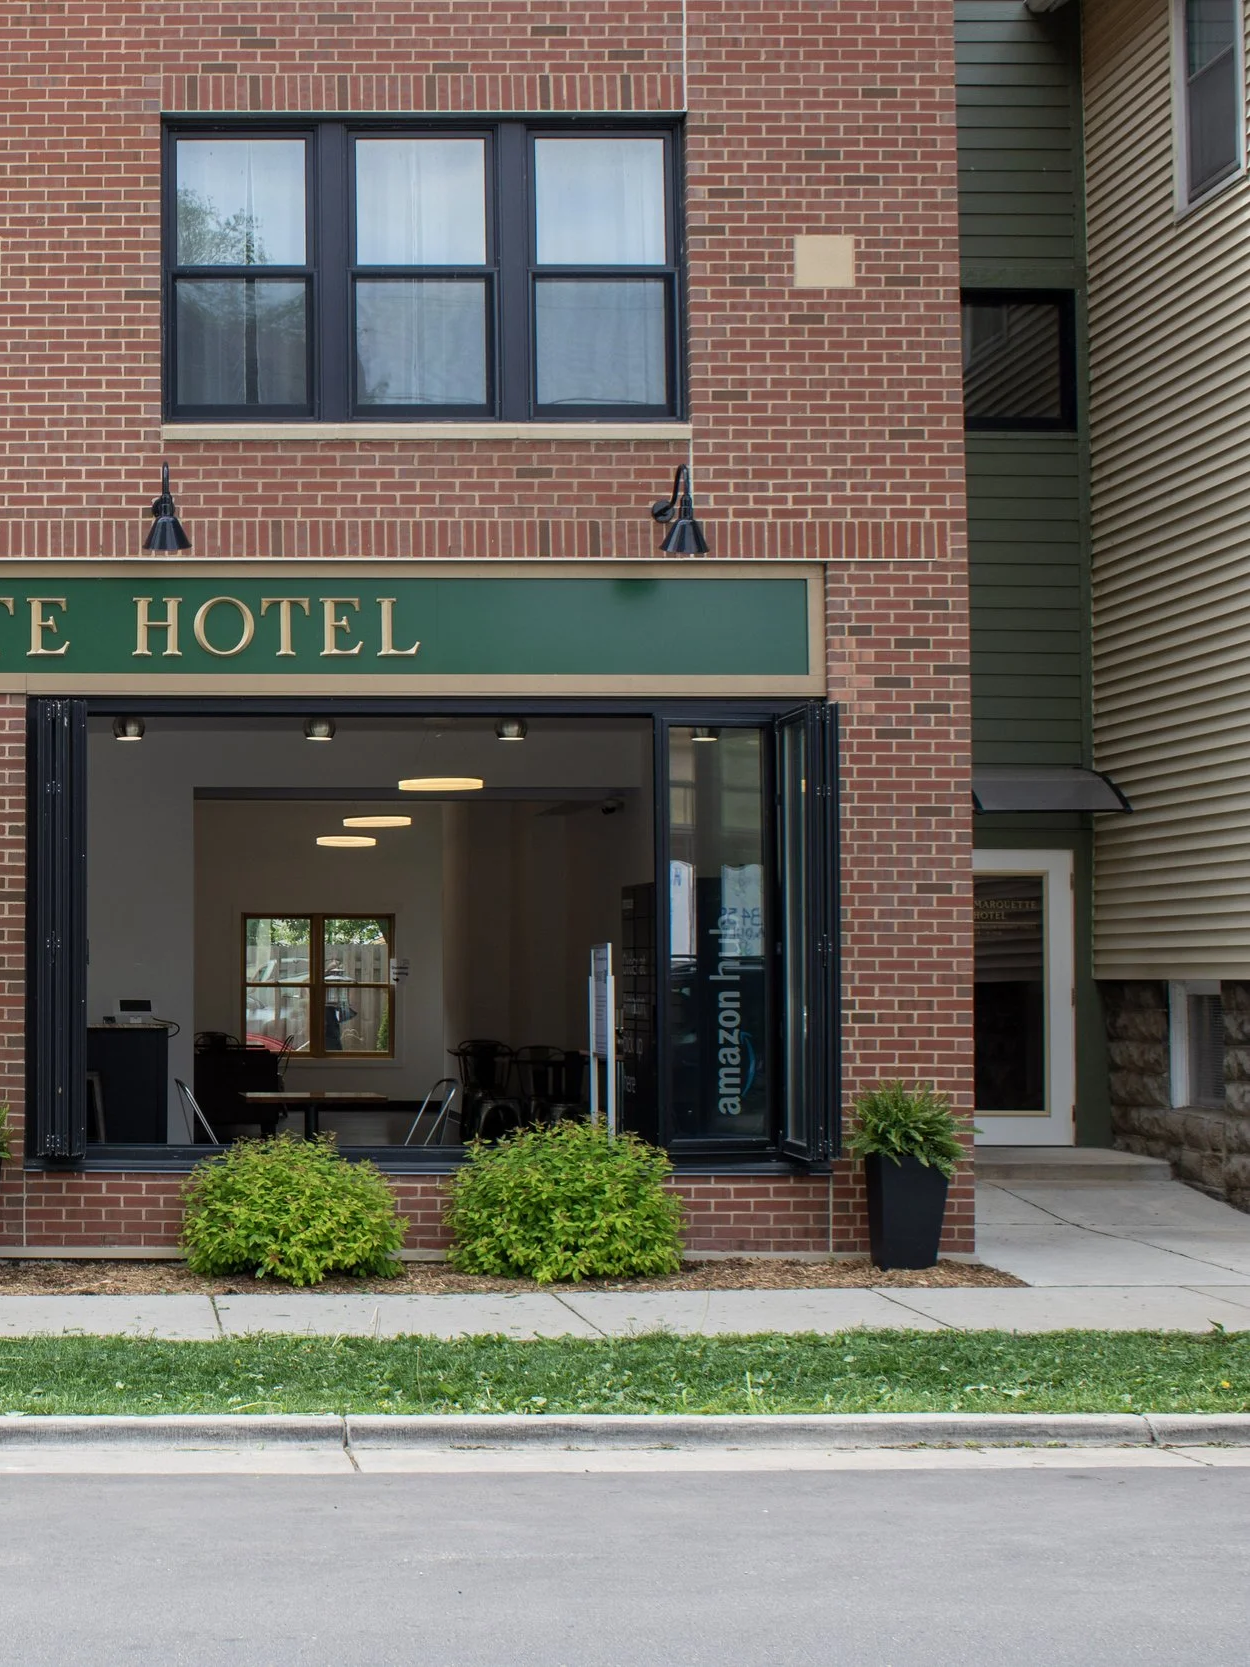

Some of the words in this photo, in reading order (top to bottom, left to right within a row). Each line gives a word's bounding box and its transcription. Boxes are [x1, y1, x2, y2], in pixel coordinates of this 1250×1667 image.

[132, 597, 422, 658] HOTEL
[974, 900, 1038, 909] MARQUETTE
[974, 911, 1007, 920] HOTEL
[708, 912, 742, 981] hub
[717, 990, 742, 1116] amazon
